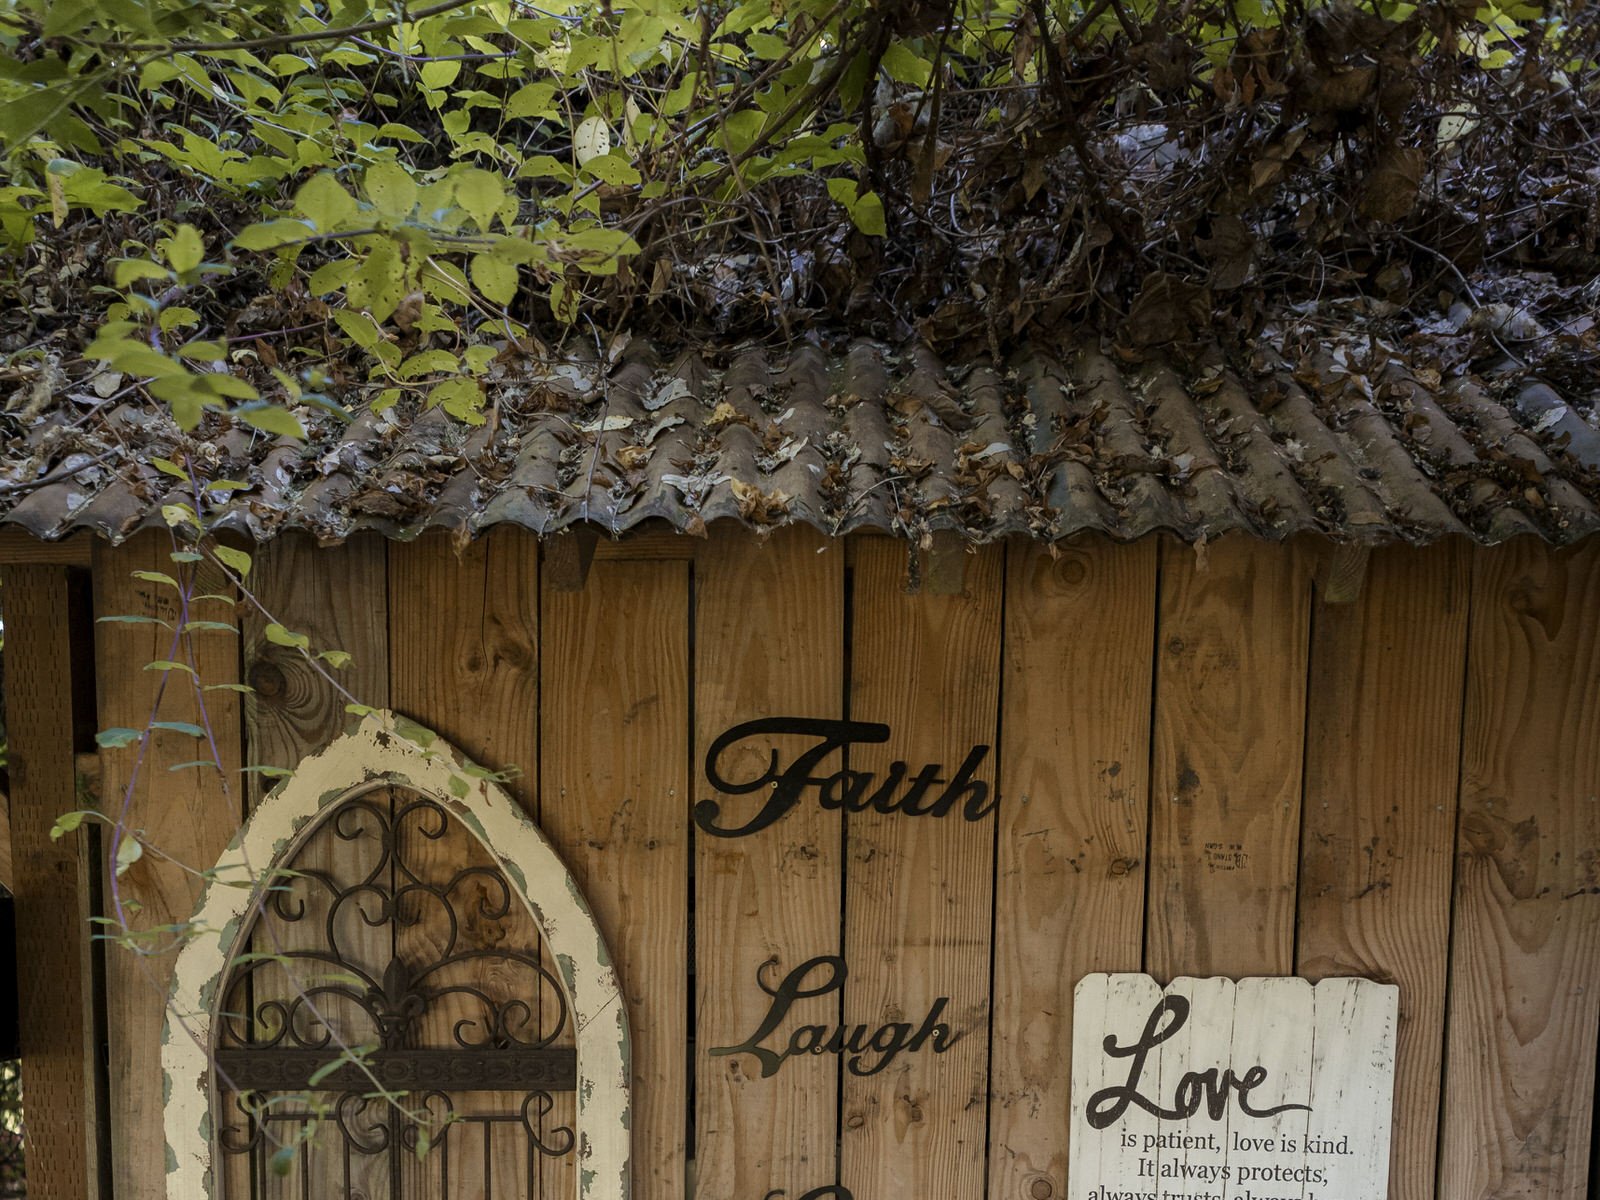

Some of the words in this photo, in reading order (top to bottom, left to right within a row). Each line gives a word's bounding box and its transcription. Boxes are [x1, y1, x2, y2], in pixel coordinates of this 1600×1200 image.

[694, 716, 1000, 838] Faith
[708, 955, 960, 1078] Laugh
[1085, 994, 1313, 1130] Love
[1120, 1128, 1137, 1147] is
[1142, 1130, 1221, 1154] patient,
[1232, 1131, 1275, 1151] love
[1280, 1133, 1297, 1152] is
[1303, 1134, 1354, 1155] kind.
[1137, 1158, 1155, 1177] It
[1161, 1158, 1231, 1184] always
[1237, 1164, 1329, 1187] protects,
